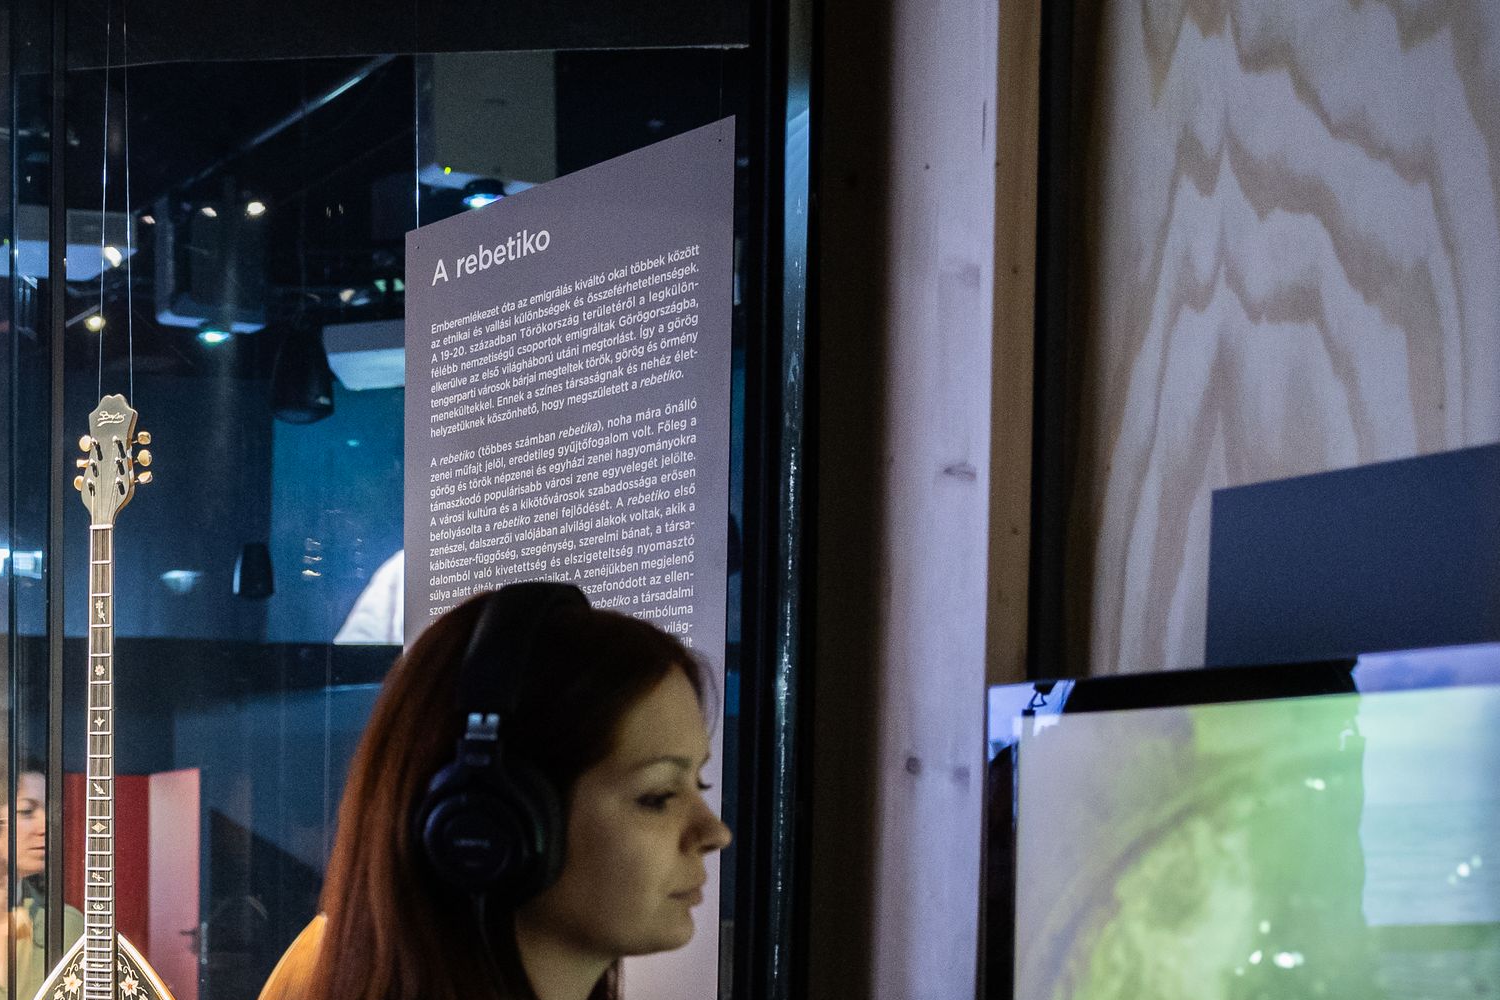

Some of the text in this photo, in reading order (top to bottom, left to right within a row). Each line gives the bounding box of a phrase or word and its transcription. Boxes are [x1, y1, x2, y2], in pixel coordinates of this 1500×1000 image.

[431, 228, 551, 287] A rebetiko
[431, 244, 699, 334] Emberemlékezet óta az emigrálás kiváltó okai többek között
[430, 262, 699, 349] az etnikai és vallási különbségek és összeférhetetlenségek.
[431, 281, 699, 364] A 19-20. században Törökország területéről a legkülön-
[430, 298, 698, 378] félébb nemzetiségű csoportok emigráltak Görögországba,
[430, 314, 698, 393] elkerülve az első világháború utáni megtorlást. Így a görög
[430, 331, 698, 408] tengerparti városok bárjai megteltek török, görög és örmény
[430, 347, 698, 423] menekültekkel. Ennek a színes társaságnak és nehéz élet-
[430, 369, 684, 438] helyzetüknek köszönhető, hogy megszületett a rebetiko.
[430, 397, 697, 467] A rebetiko (többes számban rebetika), noha mára önálló
[430, 417, 696, 482] zenei műfajt jelöl, eredetileg gyűjtőfogalom volt. Főleg a
[429, 482, 695, 541] befolyásolta a rebetiko zenei fejlődését. A rebetiko első
[430, 451, 696, 512] támaszkodó populárisabb városi zene egyvelegét jelölte.
[429, 501, 695, 557] zenészei, dalszerzői valójában alvilági alakok voltak, akik a
[429, 520, 695, 571] kábítószer-függőség, szegénység, szerelmi bánat, a társa-
[429, 589, 450, 601] súlya
[452, 586, 471, 597] alatt
[473, 581, 494, 594] élték
[573, 568, 581, 580] A
[583, 562, 638, 578] zenéjükben
[641, 551, 694, 569] megjelenő
[590, 585, 694, 609] rebetiko a társadalmi
[649, 575, 661, 585] az
[664, 570, 694, 583] ellen-
[632, 605, 693, 619] szimbóluma
[663, 620, 693, 633] világ-
